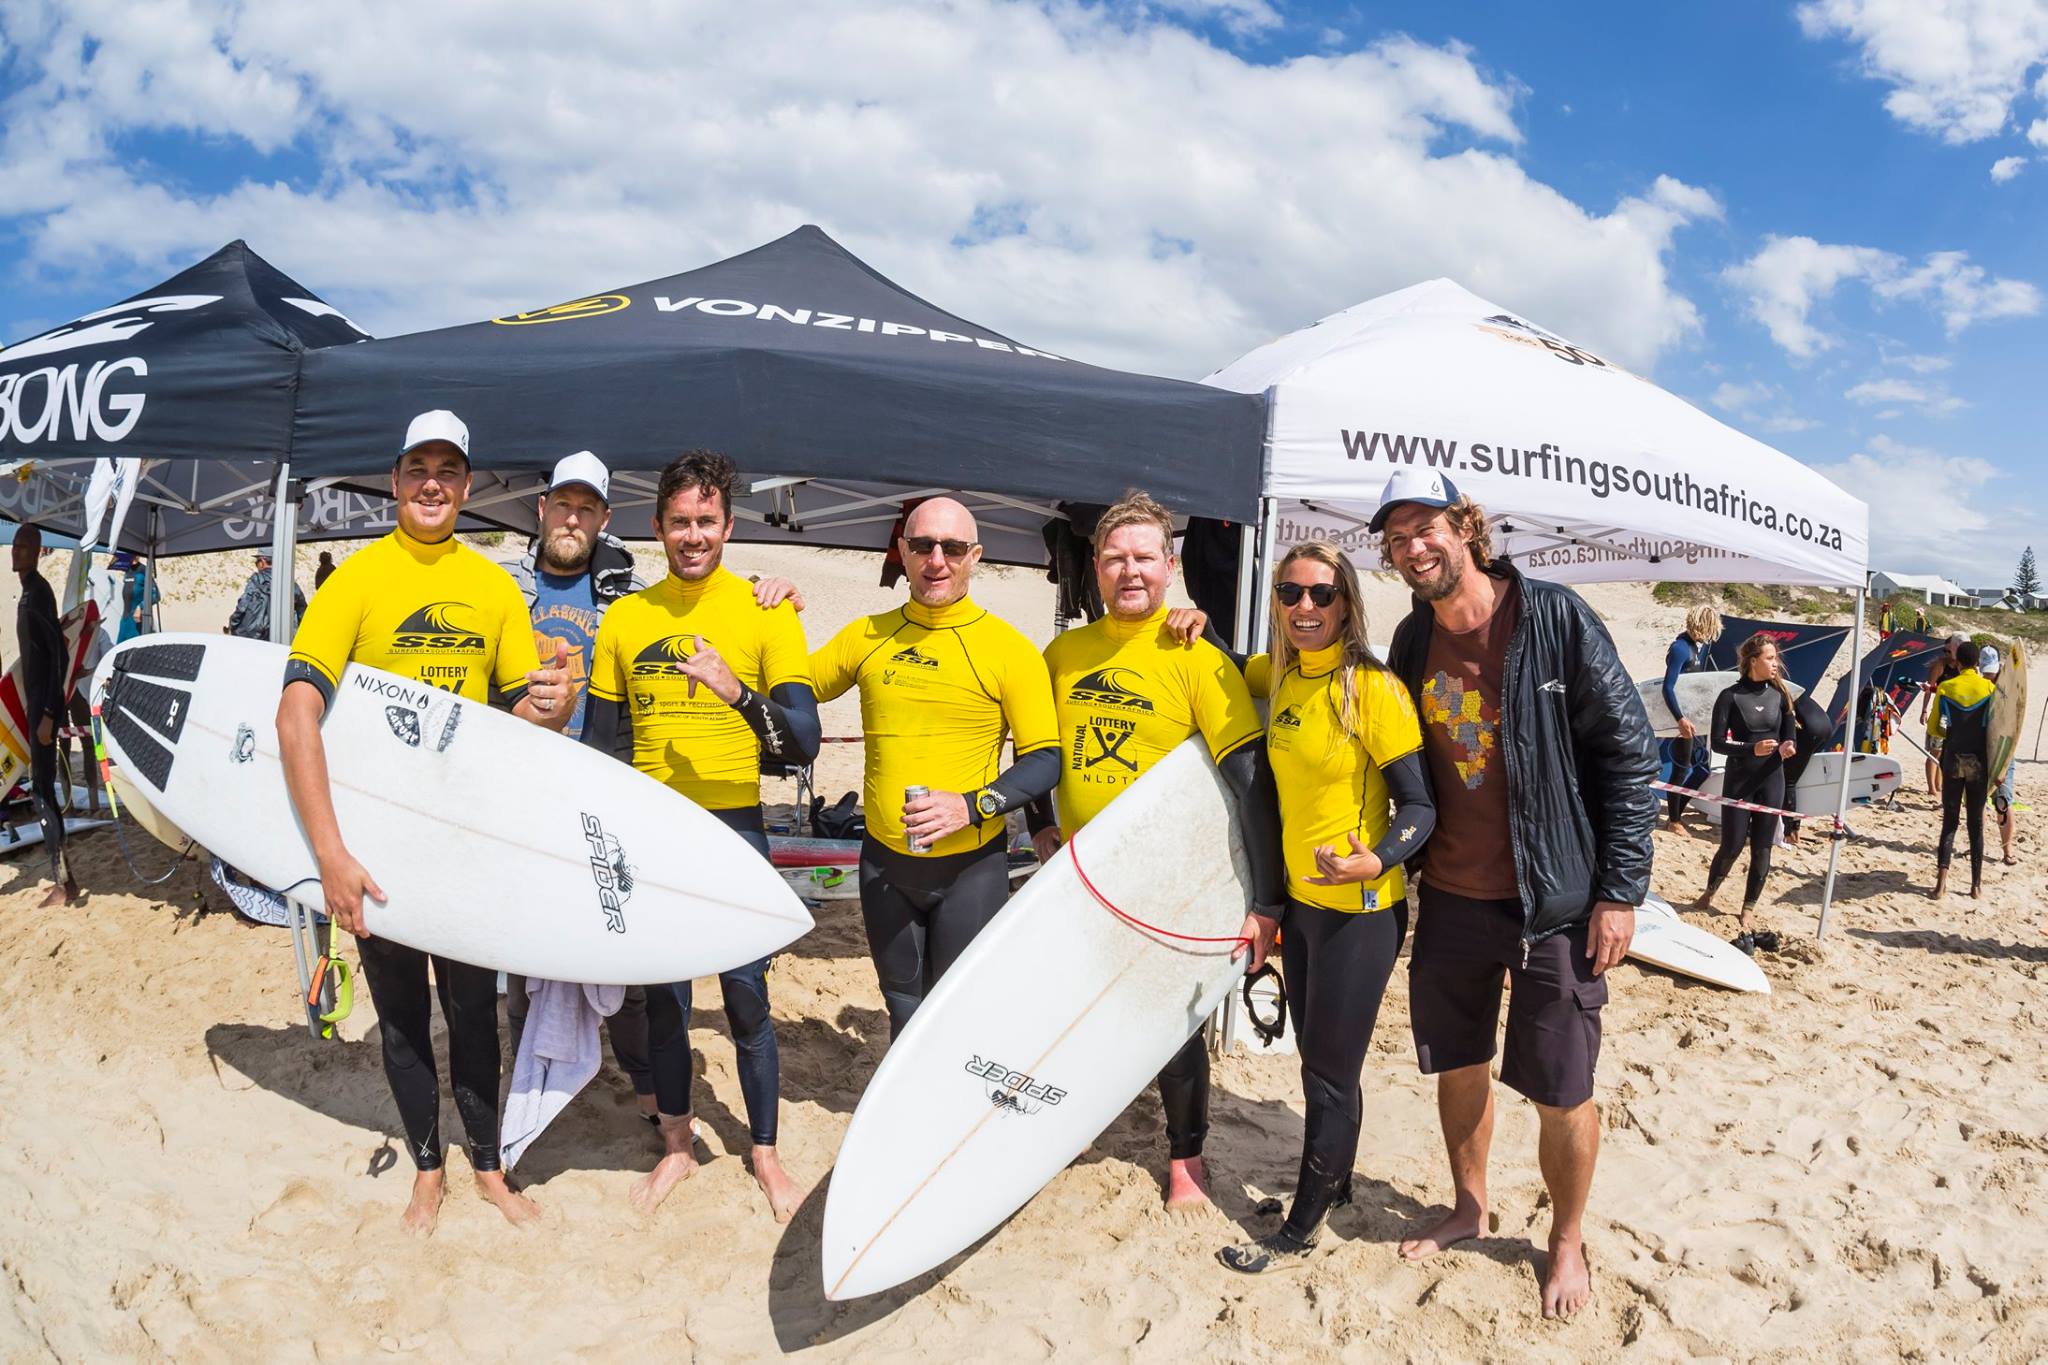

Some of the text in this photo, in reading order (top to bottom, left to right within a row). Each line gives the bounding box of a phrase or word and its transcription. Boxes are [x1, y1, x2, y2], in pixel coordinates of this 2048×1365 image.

[0, 356, 148, 444] BONG
[1341, 429, 1843, 552] www.surfingsouthafrica.co.za
[392, 635, 486, 649] SSA
[632, 664, 688, 675] SS
[890, 654, 939, 667] SSA
[420, 665, 469, 678] LOTTERY
[354, 673, 416, 705] NIXON
[1069, 691, 1154, 711] SSA
[1089, 716, 1137, 731] LOTTERY
[1072, 724, 1087, 770] NATIONAL
[1083, 774, 1138, 785] NLDT
[581, 812, 625, 933] SPIDER
[965, 1054, 1068, 1106] SPIDER
